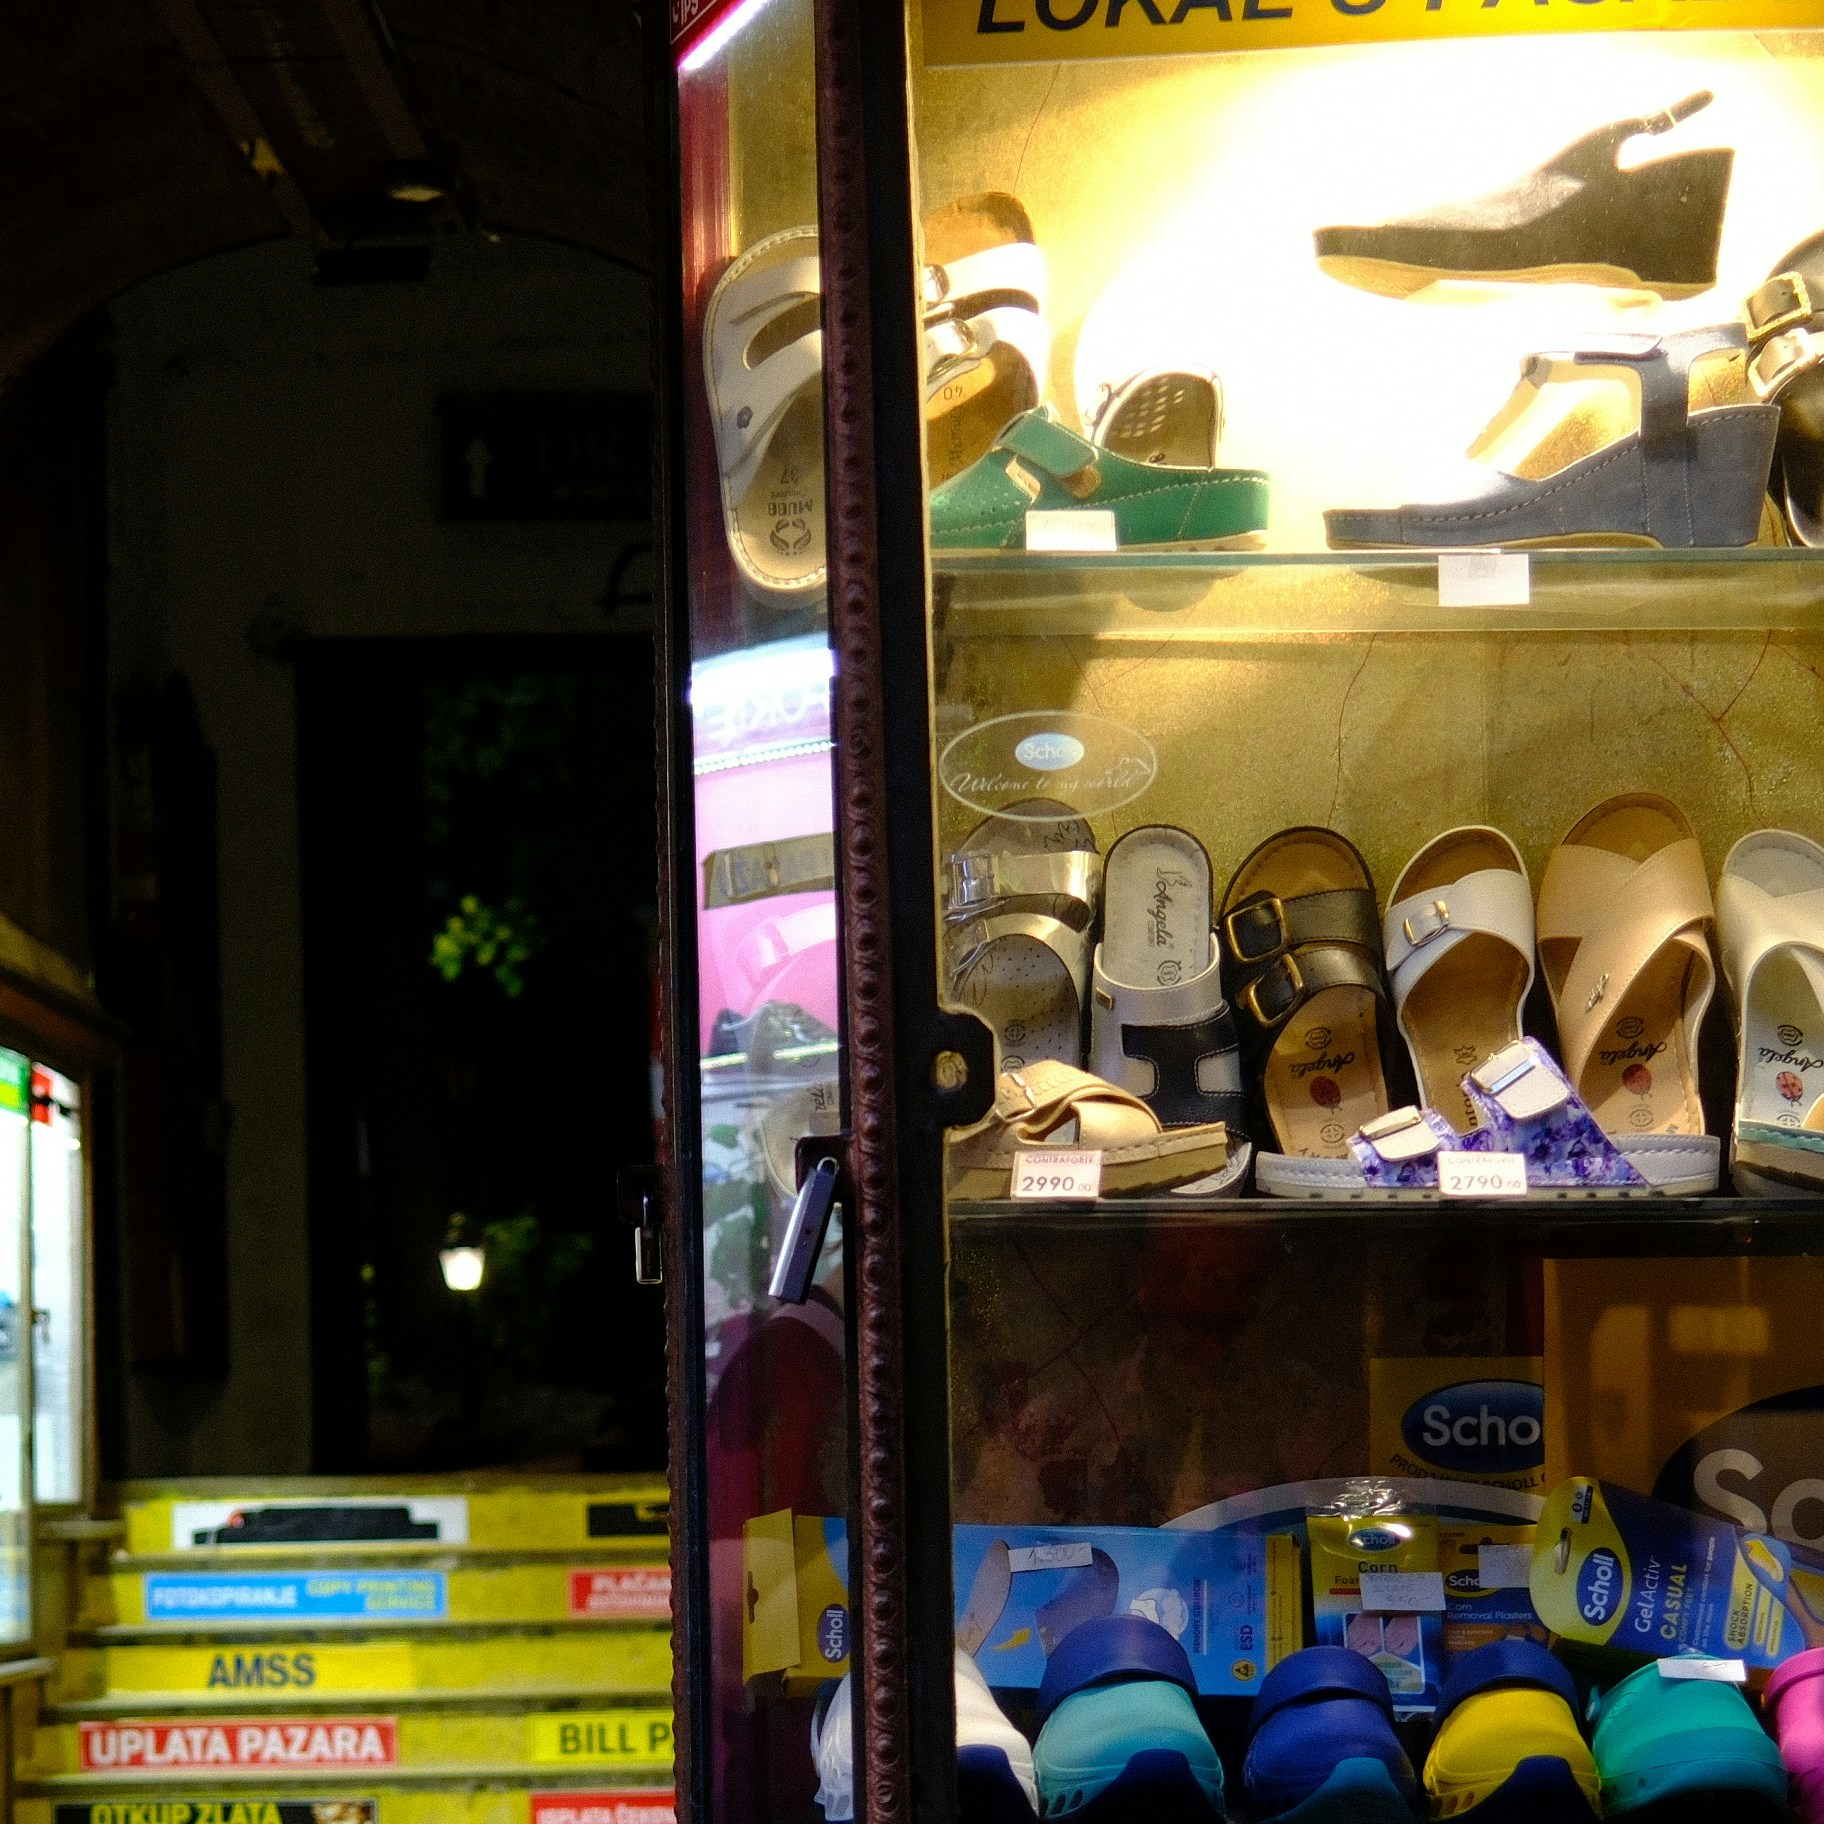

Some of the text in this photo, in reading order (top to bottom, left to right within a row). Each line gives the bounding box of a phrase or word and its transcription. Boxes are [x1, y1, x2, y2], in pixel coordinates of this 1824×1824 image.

[1146, 880, 1175, 948] Angela
[1758, 1045, 1824, 1071] Angela
[1357, 1561, 1398, 1574] Corn
[1583, 1553, 1616, 1621] Scholl
[1634, 1556, 1663, 1634] GelActiv
[1659, 1563, 1688, 1641] CASUAL
[1738, 1582, 1754, 1646] ABSORPTION
[823, 1609, 845, 1660] Scholl
[1240, 1624, 1254, 1651] ESD
[208, 1653, 316, 1689] AMSS
[88, 1726, 386, 1767] UPLATA PAZARA
[560, 1722, 638, 1755] BILL
